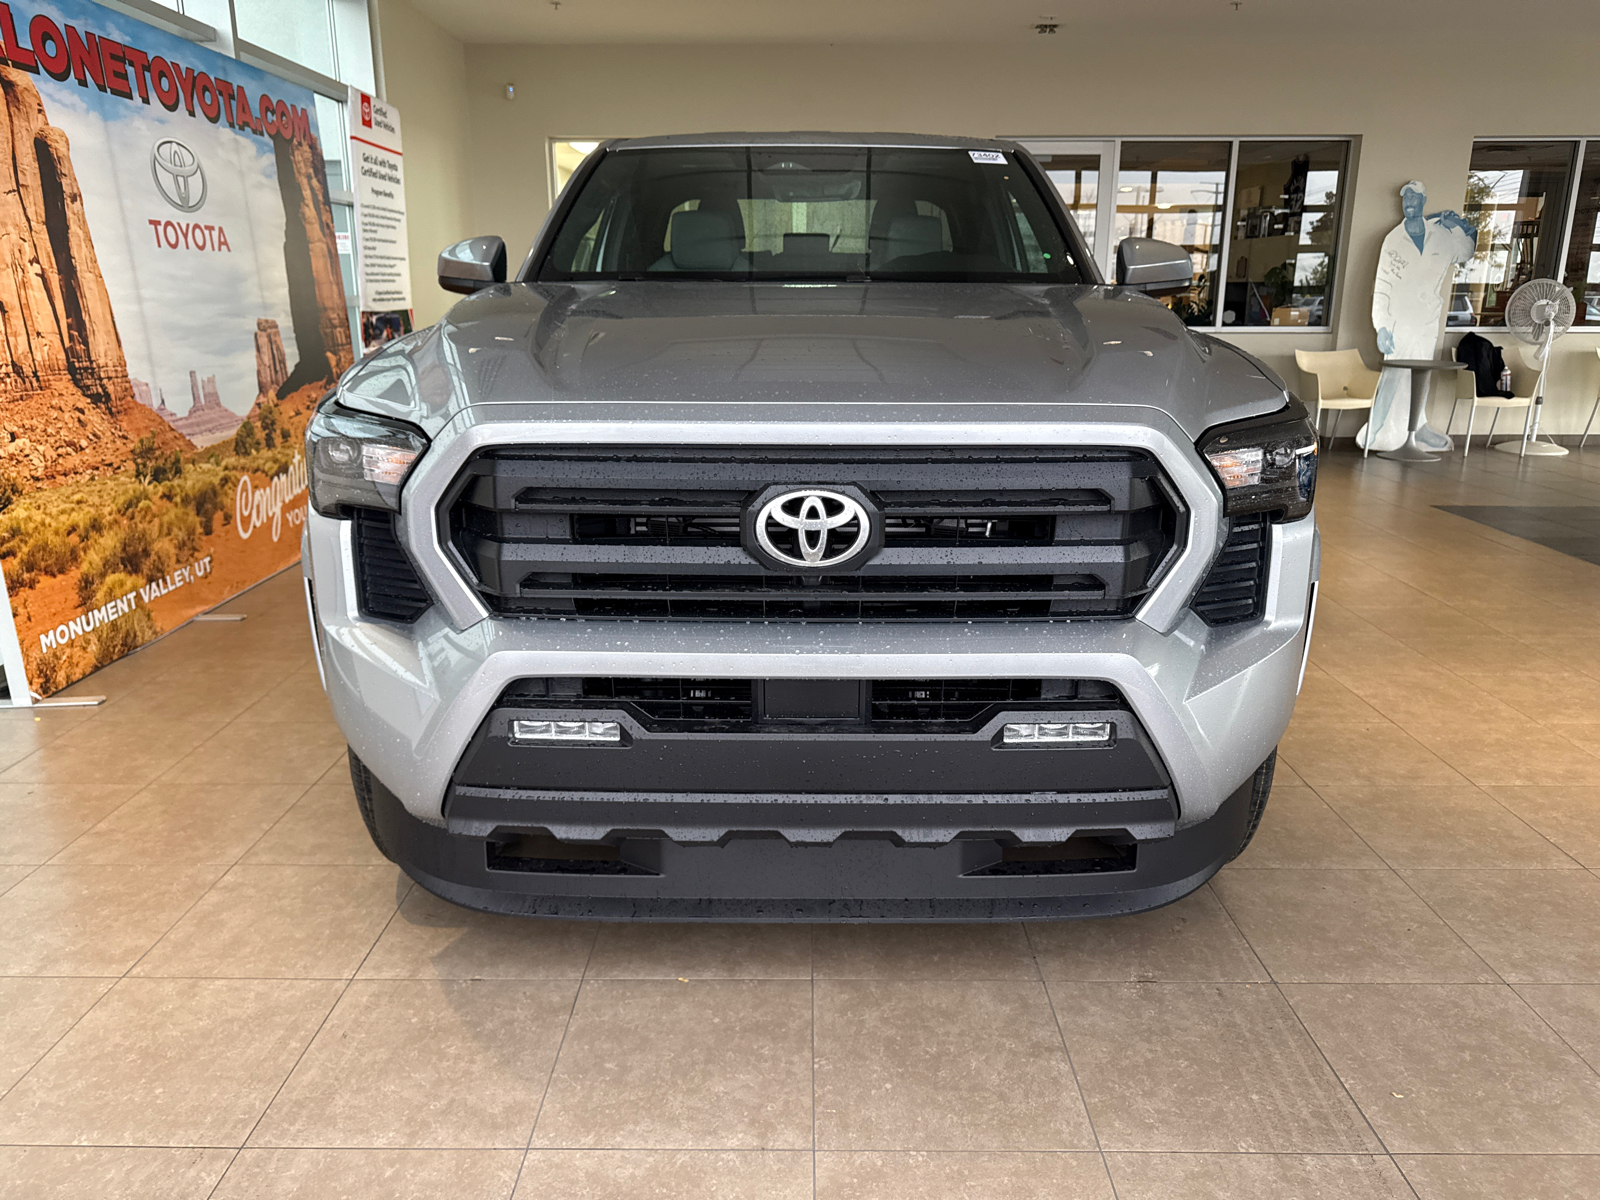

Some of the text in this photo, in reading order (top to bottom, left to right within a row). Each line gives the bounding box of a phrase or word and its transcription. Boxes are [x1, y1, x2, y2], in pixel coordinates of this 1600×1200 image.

[0, 1, 313, 145] LONETOYOTA.COM
[148, 219, 231, 252] TOYOTA
[39, 556, 212, 654] MONUMENT VALLEY, UT
